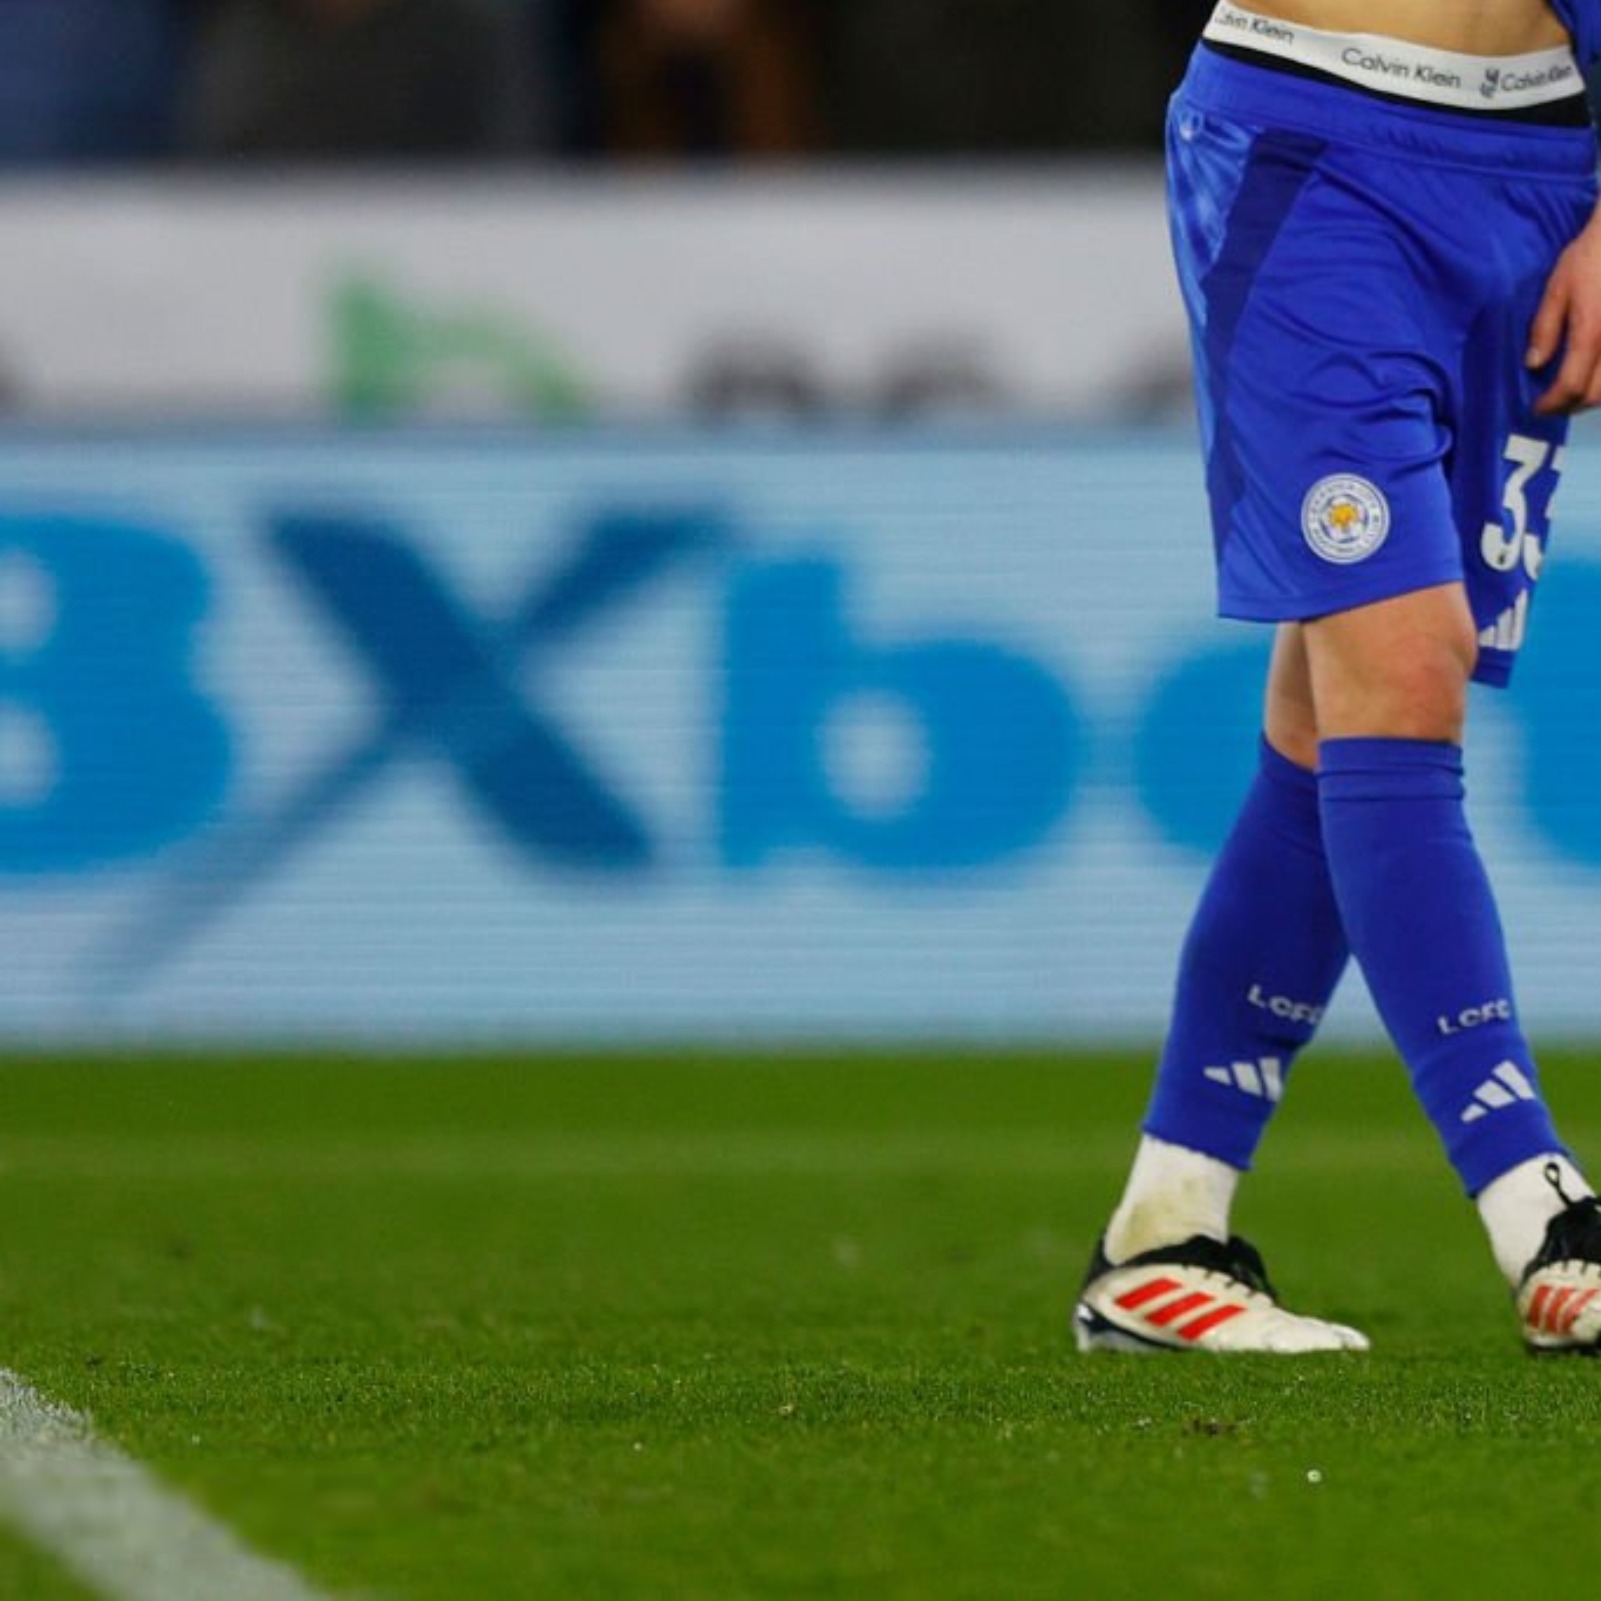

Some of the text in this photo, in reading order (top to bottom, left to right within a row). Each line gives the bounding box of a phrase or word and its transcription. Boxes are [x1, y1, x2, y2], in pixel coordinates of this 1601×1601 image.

[1251, 17, 1295, 45] Klein
[1341, 47, 1461, 88] Calvin Klein
[1437, 998, 1510, 1035] LCFC
